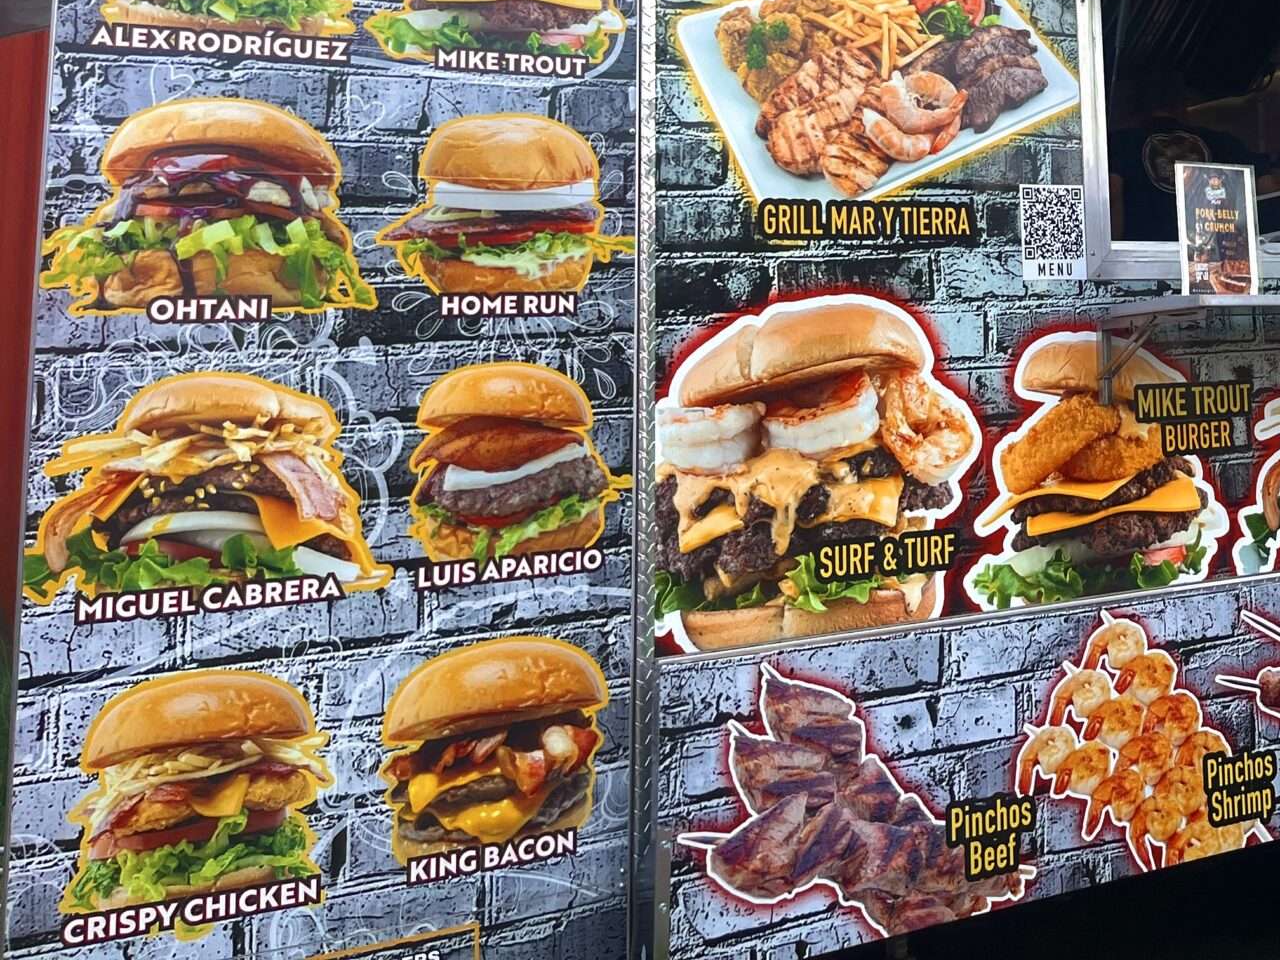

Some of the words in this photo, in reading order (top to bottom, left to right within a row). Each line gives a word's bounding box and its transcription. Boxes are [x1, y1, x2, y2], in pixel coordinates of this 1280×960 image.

[92, 26, 171, 50] ALEX
[179, 27, 348, 62] RODRÍGUEZ
[437, 49, 499, 73] MIKE
[506, 52, 587, 77] TROUT
[763, 204, 823, 235] GRILL
[831, 205, 878, 235] MAR
[882, 206, 896, 234] Y
[901, 206, 971, 235] TIERRA
[1195, 208, 1239, 220] PORK-BELLY
[1205, 222, 1235, 232] CRUNCH
[1037, 262, 1074, 277] MENU
[150, 298, 269, 321] OHTANI
[442, 295, 516, 317] HOME
[518, 294, 576, 315] RUN
[1137, 388, 1187, 418] MIKE
[1193, 383, 1250, 416] TROUT
[1165, 420, 1230, 451] BURGER
[417, 562, 476, 589] LUIS
[482, 549, 603, 580] APARICIO
[819, 542, 875, 578] SURF
[884, 538, 899, 571] &
[904, 534, 955, 569] TURF
[78, 593, 195, 622] MIGUEL
[202, 576, 342, 609] CABRERA
[1207, 751, 1274, 787] Pinchos
[951, 800, 1034, 843] Pinchos
[1211, 786, 1274, 825] Shrimp
[409, 850, 476, 883] KING
[484, 832, 576, 869] BACON
[970, 839, 1018, 875] Beef
[64, 904, 179, 945] CRISPY
[183, 878, 321, 922] CHICKEN
